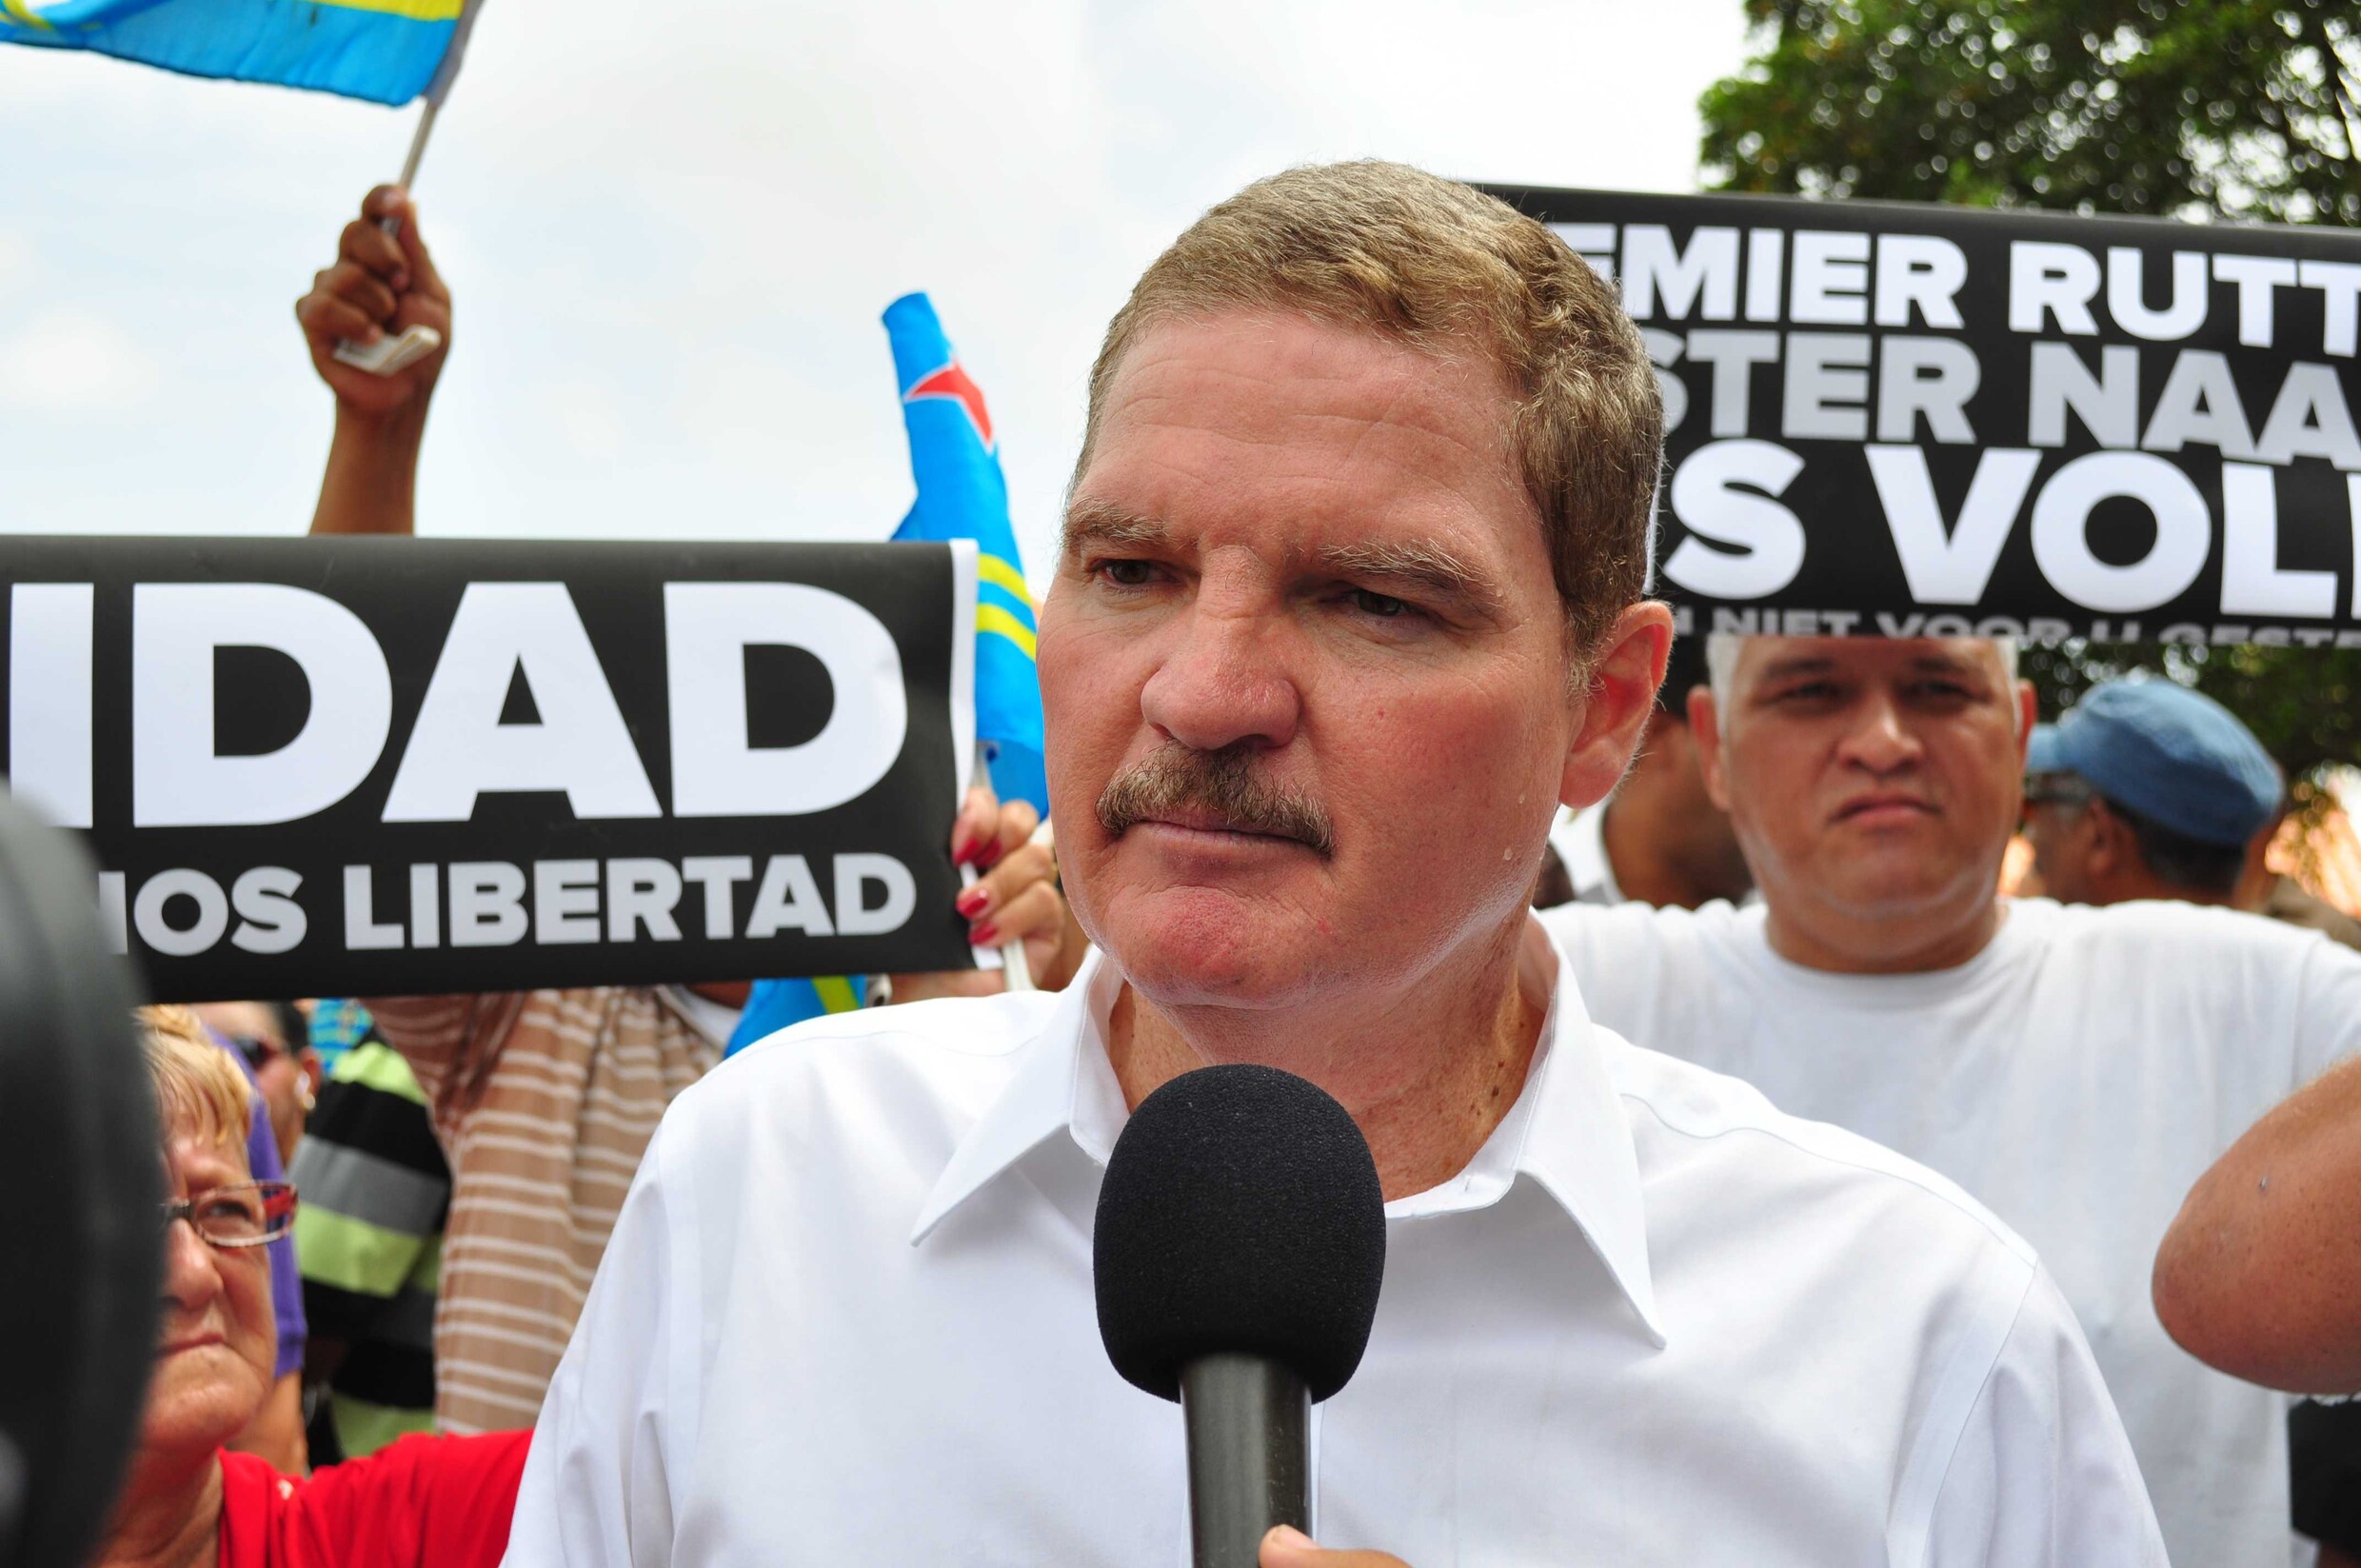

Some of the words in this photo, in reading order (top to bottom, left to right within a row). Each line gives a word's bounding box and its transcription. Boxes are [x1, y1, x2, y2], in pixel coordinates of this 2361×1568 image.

[2007, 239, 2361, 359] RUTT
[2028, 343, 2361, 472] NAA
[1644, 438, 1807, 601] S
[1864, 444, 2361, 621] VOL
[1714, 606, 1860, 638] NIET
[1875, 613, 2072, 643] VOOR
[9, 580, 908, 827] IDAD
[343, 852, 917, 951] LIBERTAD
